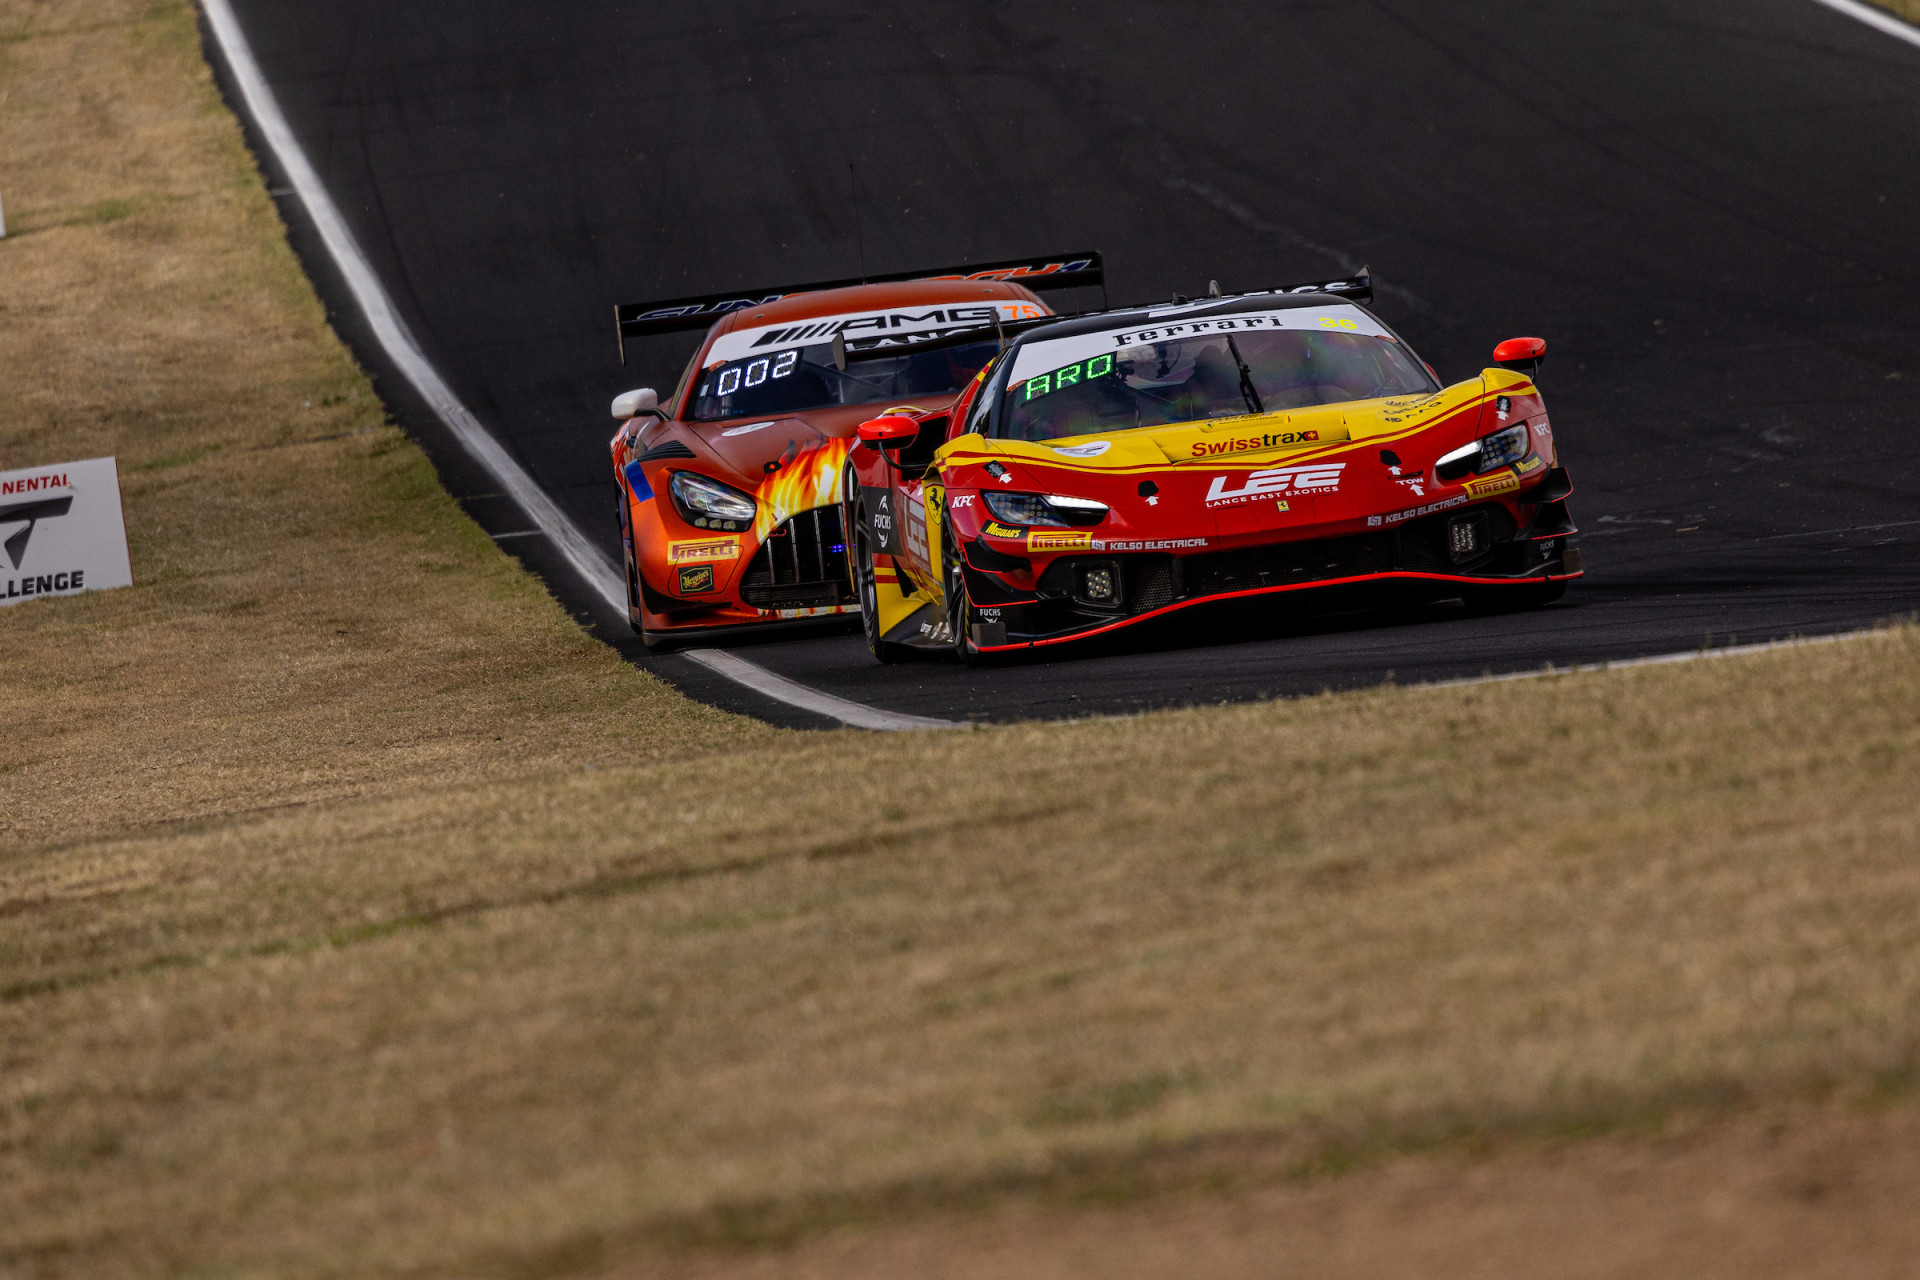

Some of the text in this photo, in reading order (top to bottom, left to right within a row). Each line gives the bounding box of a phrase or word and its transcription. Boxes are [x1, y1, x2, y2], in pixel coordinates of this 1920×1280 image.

[830, 305, 996, 335] AMG
[1002, 304, 1041, 320] 75
[1112, 315, 1284, 347] Ferrari
[1318, 317, 1358, 330] 36
[717, 350, 798, 396] 002
[1534, 422, 1551, 436] KFC
[1192, 430, 1309, 457] Swisstrax
[1205, 462, 1346, 502] LEE
[1395, 477, 1424, 486] TOW
[1469, 474, 1517, 496] PIRELLI
[951, 494, 976, 508] KFC
[1206, 485, 1339, 508] LANCE EAST EXOTICS
[1385, 494, 1469, 524] KELSO ELECTRICAL
[874, 513, 892, 530] FUCHS
[671, 539, 735, 560] PIRELLI
[1032, 533, 1087, 548] PIRELLI
[1110, 538, 1209, 551] KELSO ELECTRICAL
[980, 607, 1001, 617] FUCHS
